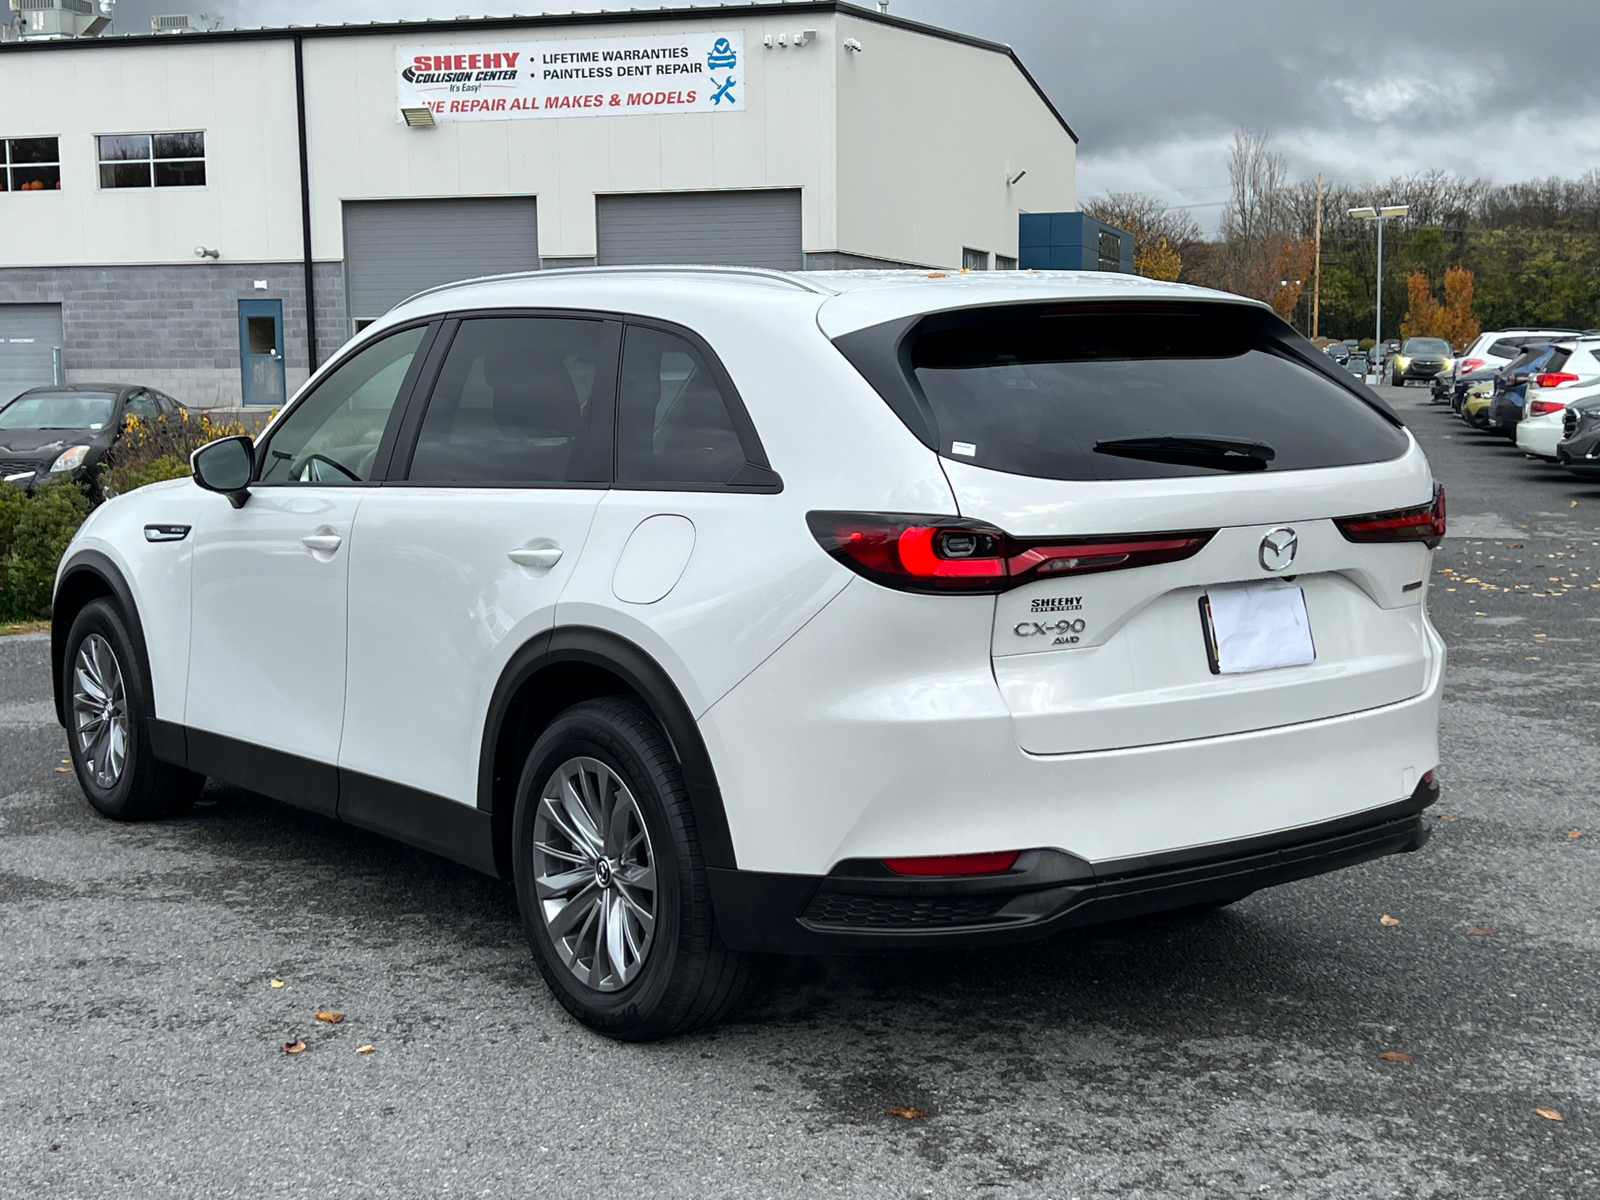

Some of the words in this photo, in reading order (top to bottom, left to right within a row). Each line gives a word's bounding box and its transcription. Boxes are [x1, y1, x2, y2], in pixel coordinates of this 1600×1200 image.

[413, 52, 520, 72] SHEEHY
[542, 51, 600, 65] LIFETIME
[602, 47, 689, 62] WARRANTIES
[415, 71, 474, 84] COLLISION
[474, 70, 518, 82] CENTER
[543, 66, 613, 80] PAINTLESS
[617, 65, 653, 77] DENT
[656, 62, 703, 76] REPAIR
[449, 83, 460, 93] It's
[461, 83, 482, 94] Easy!
[450, 98, 507, 113] REPAIR
[509, 97, 540, 111] ALL
[544, 94, 604, 109] MAKES
[608, 93, 622, 107] &
[626, 90, 698, 106] MODELS
[1031, 596, 1083, 608] SHEEHY
[1013, 618, 1086, 637] CX-90
[1051, 636, 1080, 646] AWD
